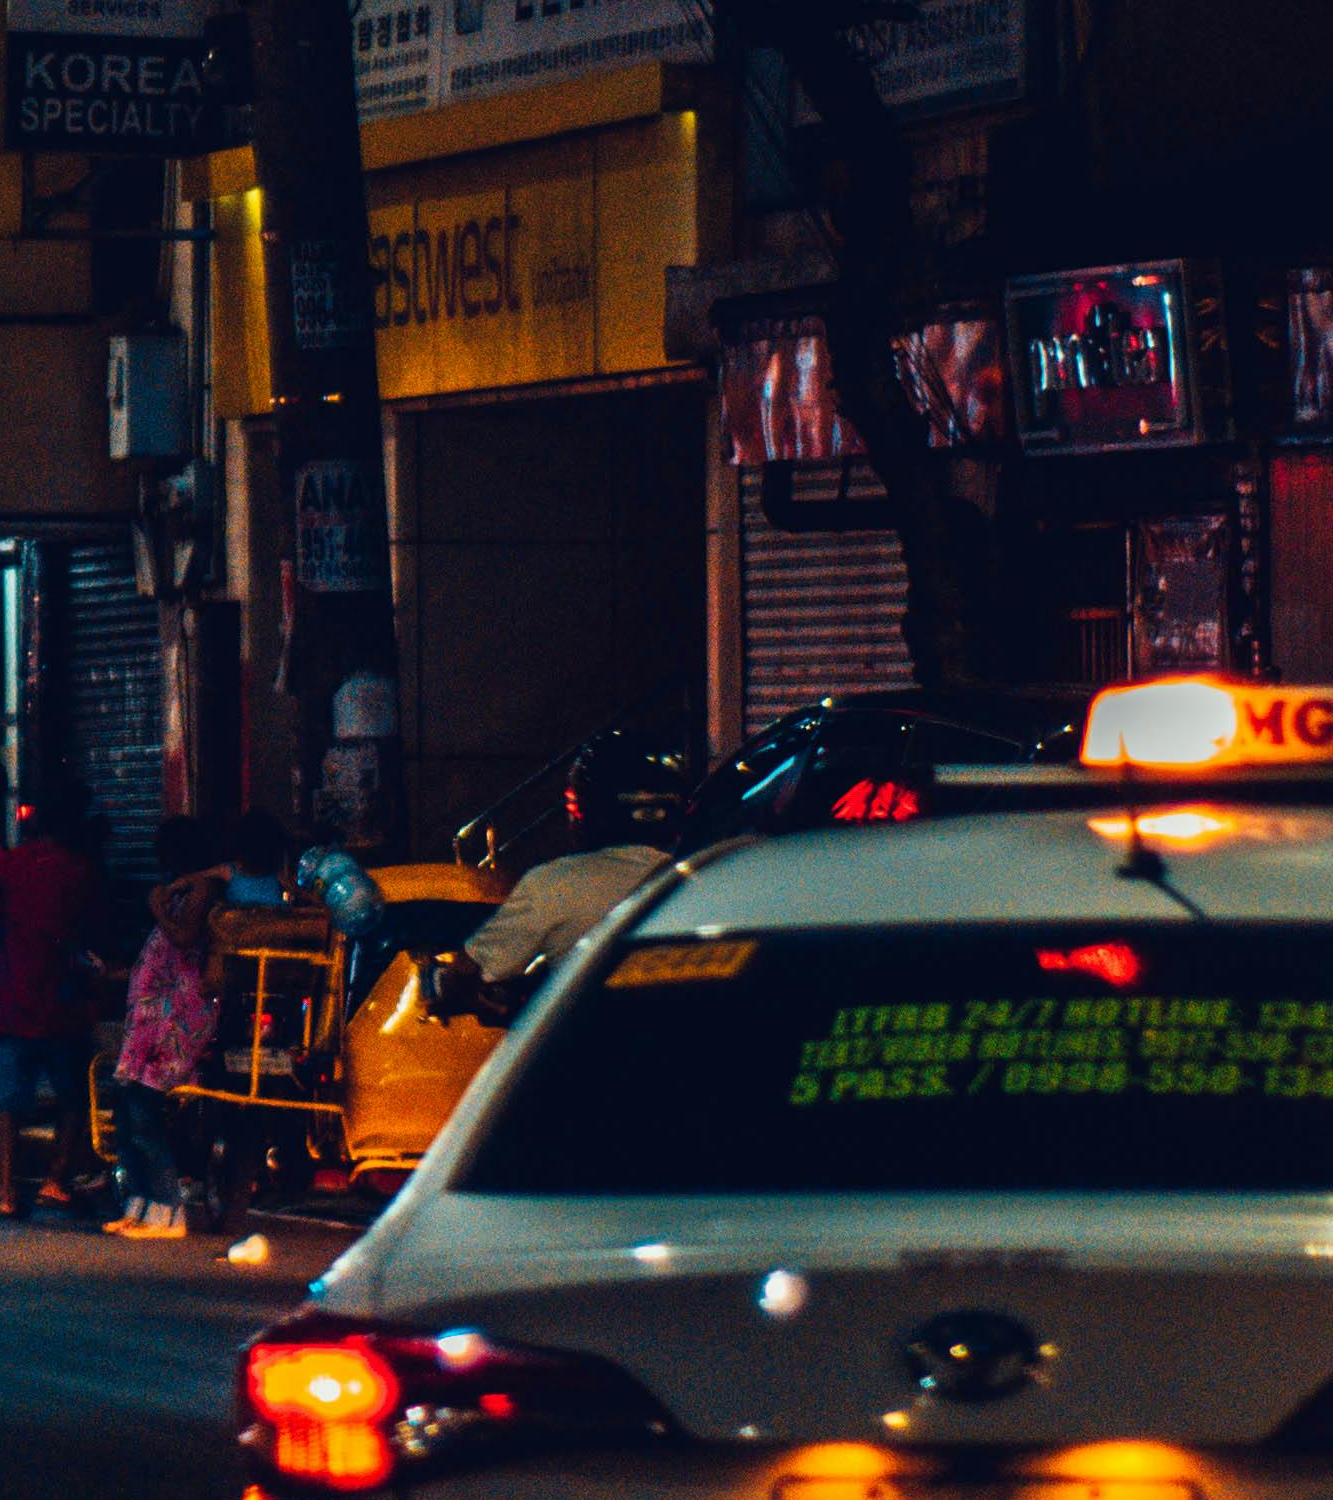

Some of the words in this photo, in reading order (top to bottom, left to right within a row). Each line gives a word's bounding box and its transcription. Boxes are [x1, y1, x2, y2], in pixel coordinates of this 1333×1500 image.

[68, 0, 162, 18] SERVICES
[24, 49, 204, 97] KOREA
[20, 96, 205, 139] SPECIALTY
[367, 213, 522, 330] astwest
